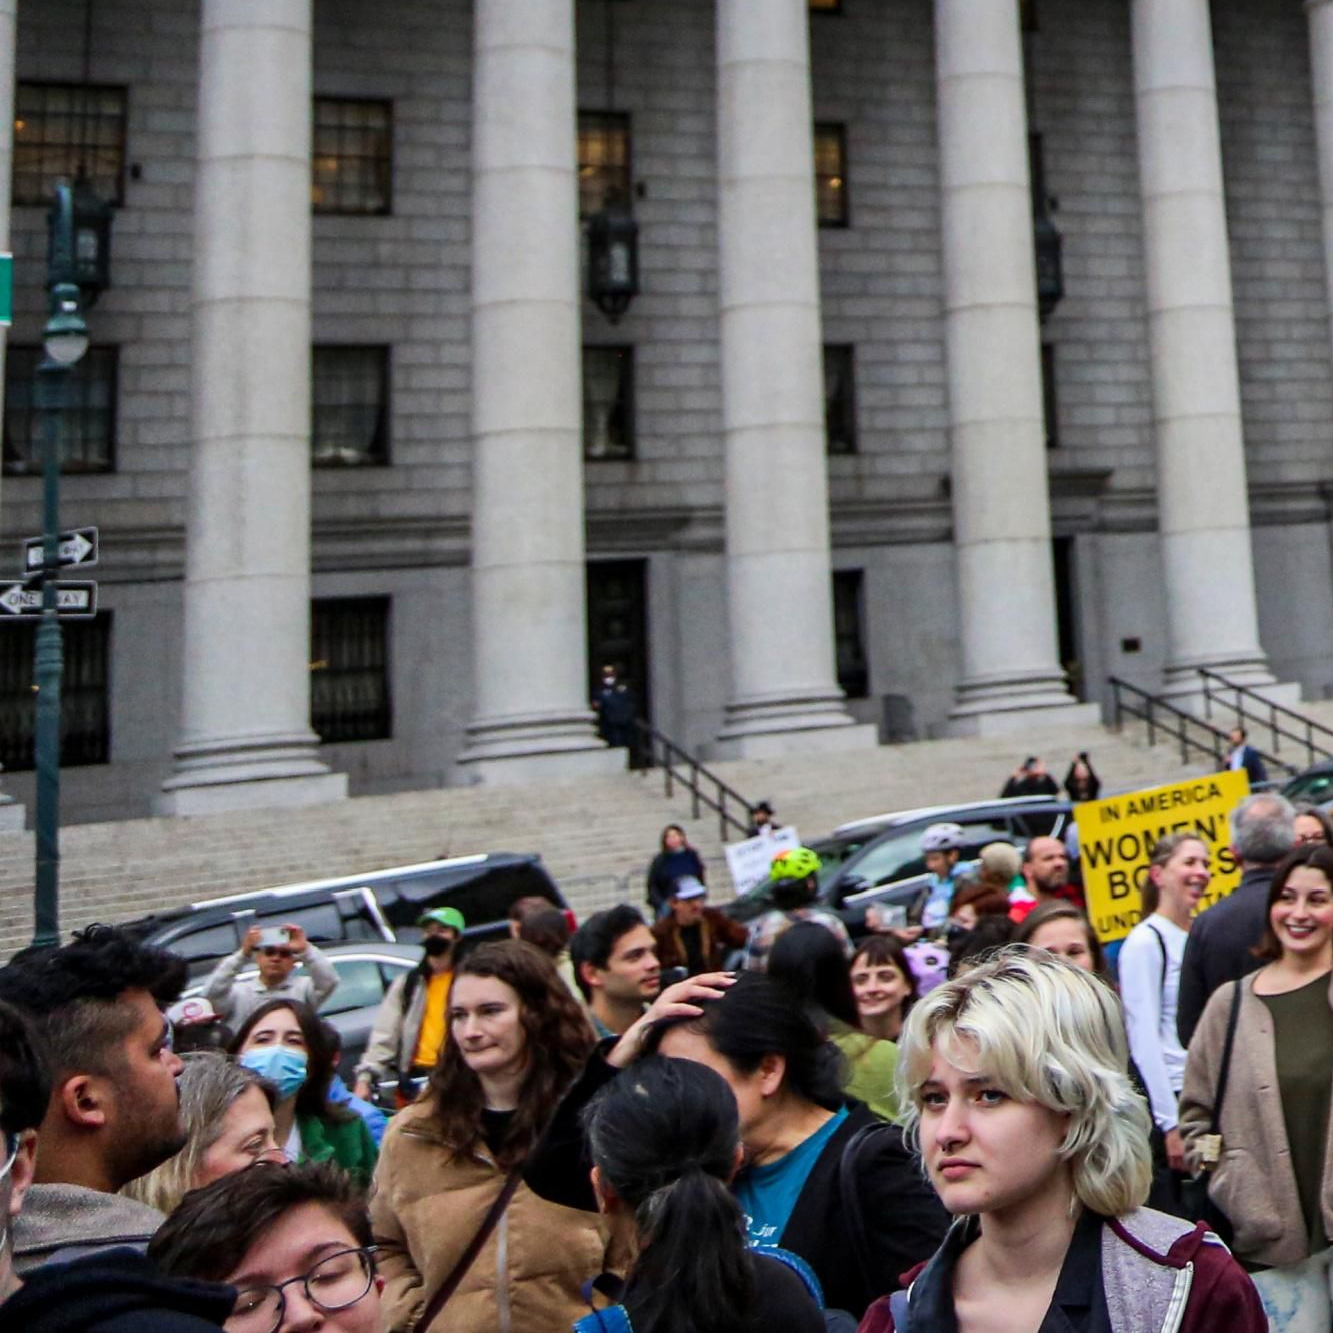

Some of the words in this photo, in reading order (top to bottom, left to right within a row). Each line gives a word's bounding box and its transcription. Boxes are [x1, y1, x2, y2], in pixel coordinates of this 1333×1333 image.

[9, 592, 35, 606] ONE
[1100, 803, 1120, 822] IN
[1127, 783, 1223, 815] AMERICA
